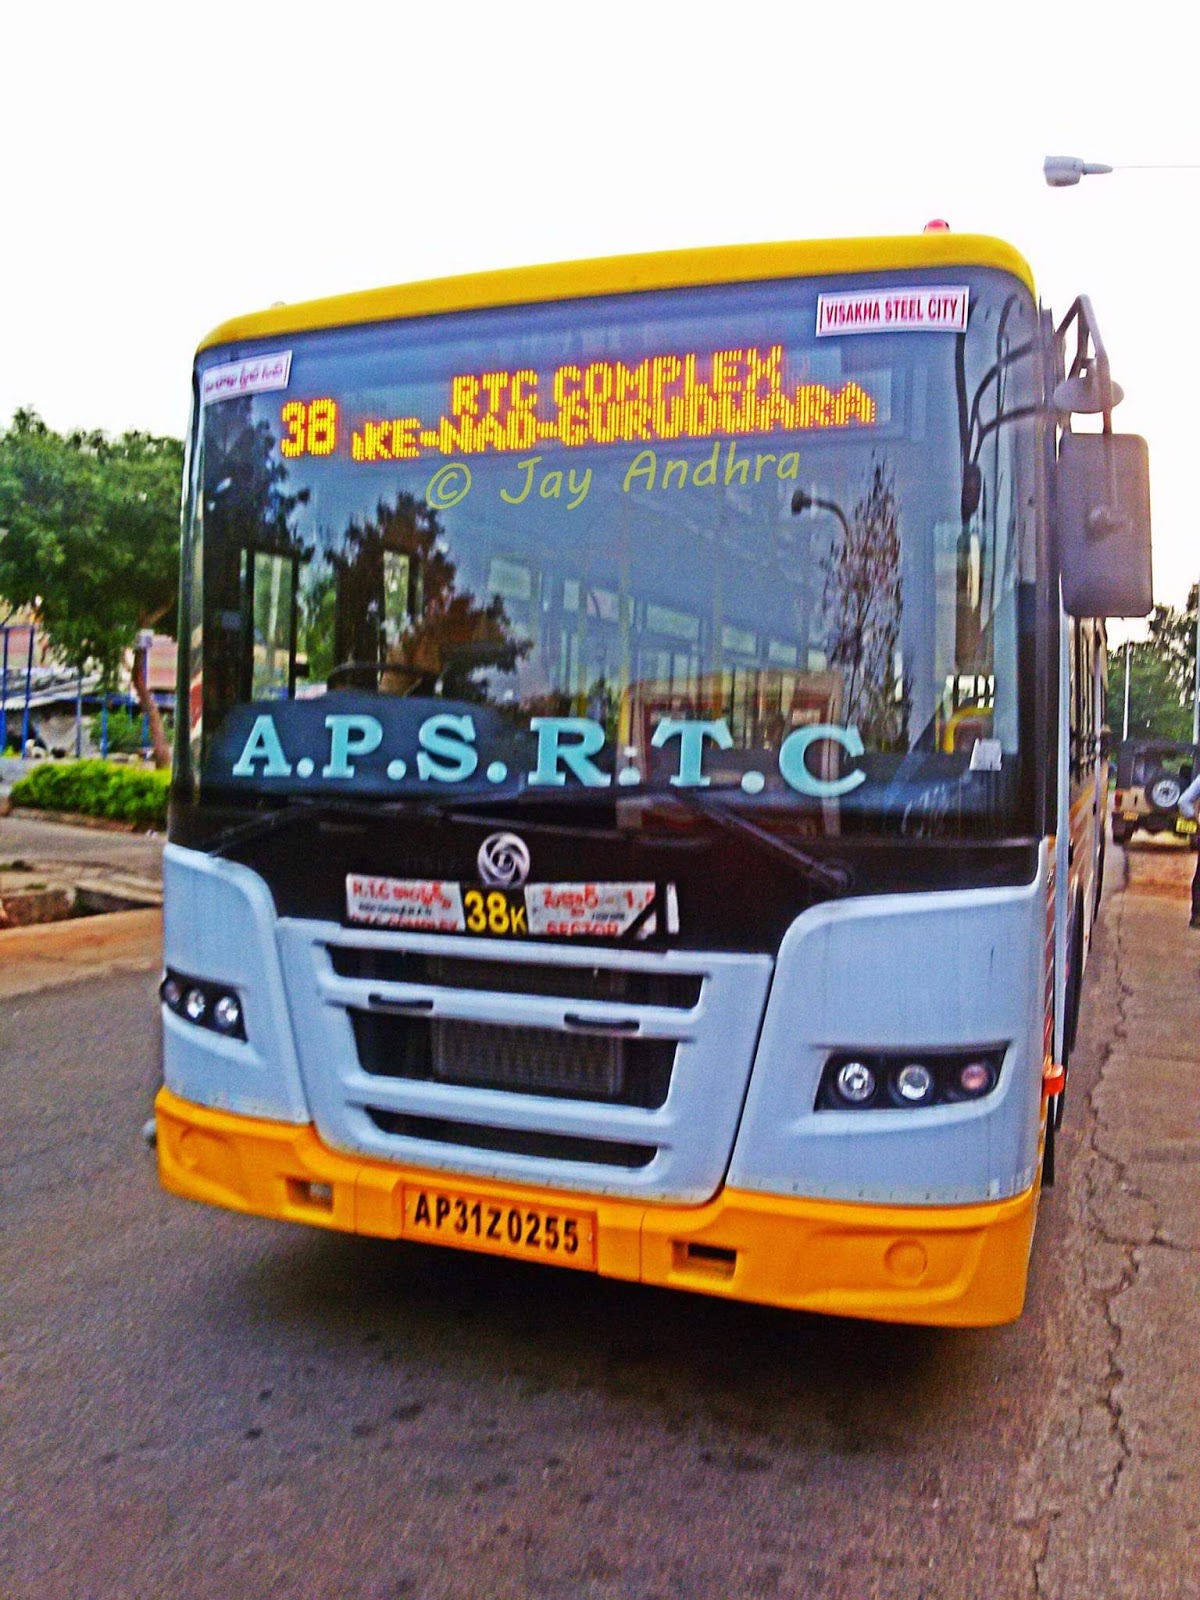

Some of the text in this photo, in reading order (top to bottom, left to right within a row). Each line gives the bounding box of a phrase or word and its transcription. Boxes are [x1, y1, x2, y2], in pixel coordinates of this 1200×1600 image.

[826, 297, 958, 326] VISAKHA STEEL CITY
[453, 344, 782, 416] RTC COMPLEX
[281, 397, 336, 458] 38
[414, 1191, 579, 1255] AP31Z0255
